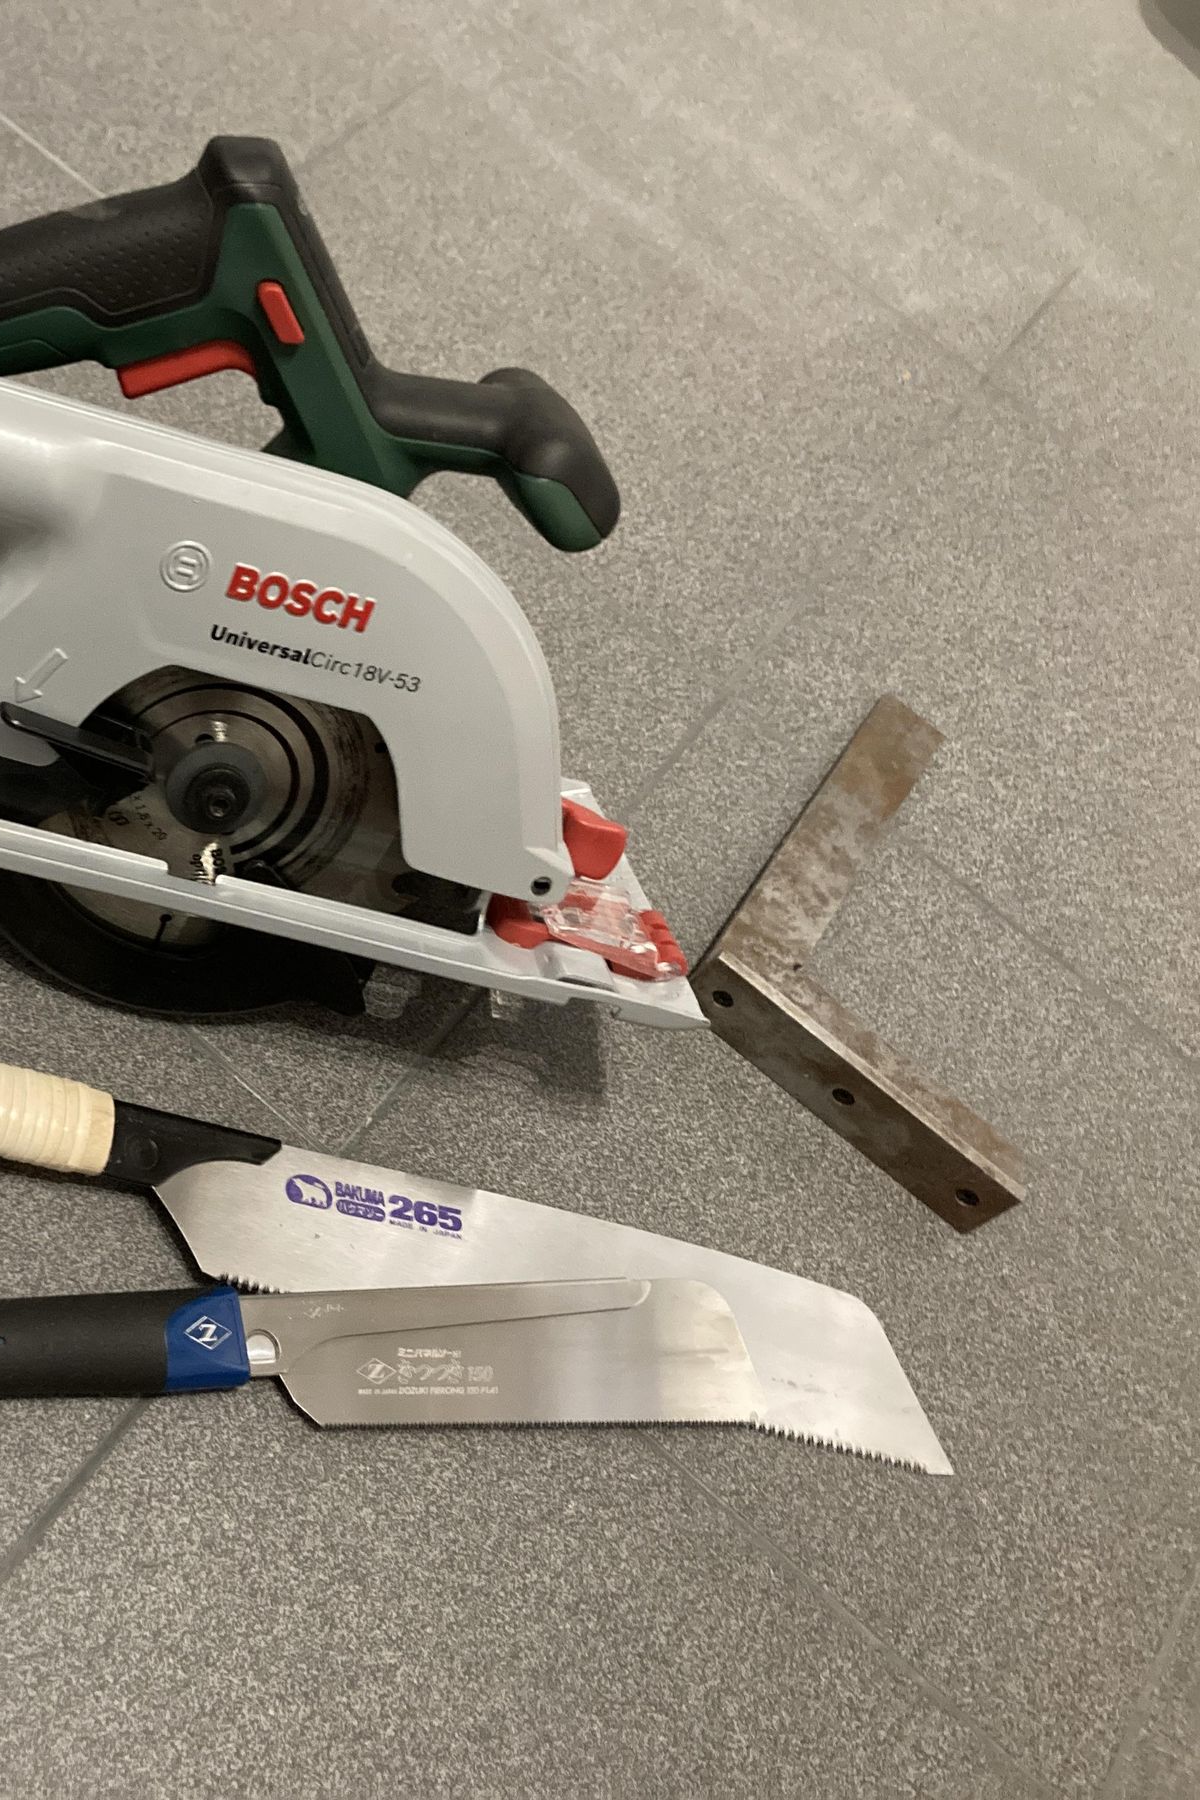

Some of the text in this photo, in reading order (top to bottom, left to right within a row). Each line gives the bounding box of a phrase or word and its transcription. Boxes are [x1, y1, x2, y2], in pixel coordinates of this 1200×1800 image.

[224, 561, 377, 634] BOSCH
[388, 1194, 463, 1232] 265
[389, 1219, 464, 1240] MADE IN JAPAN
